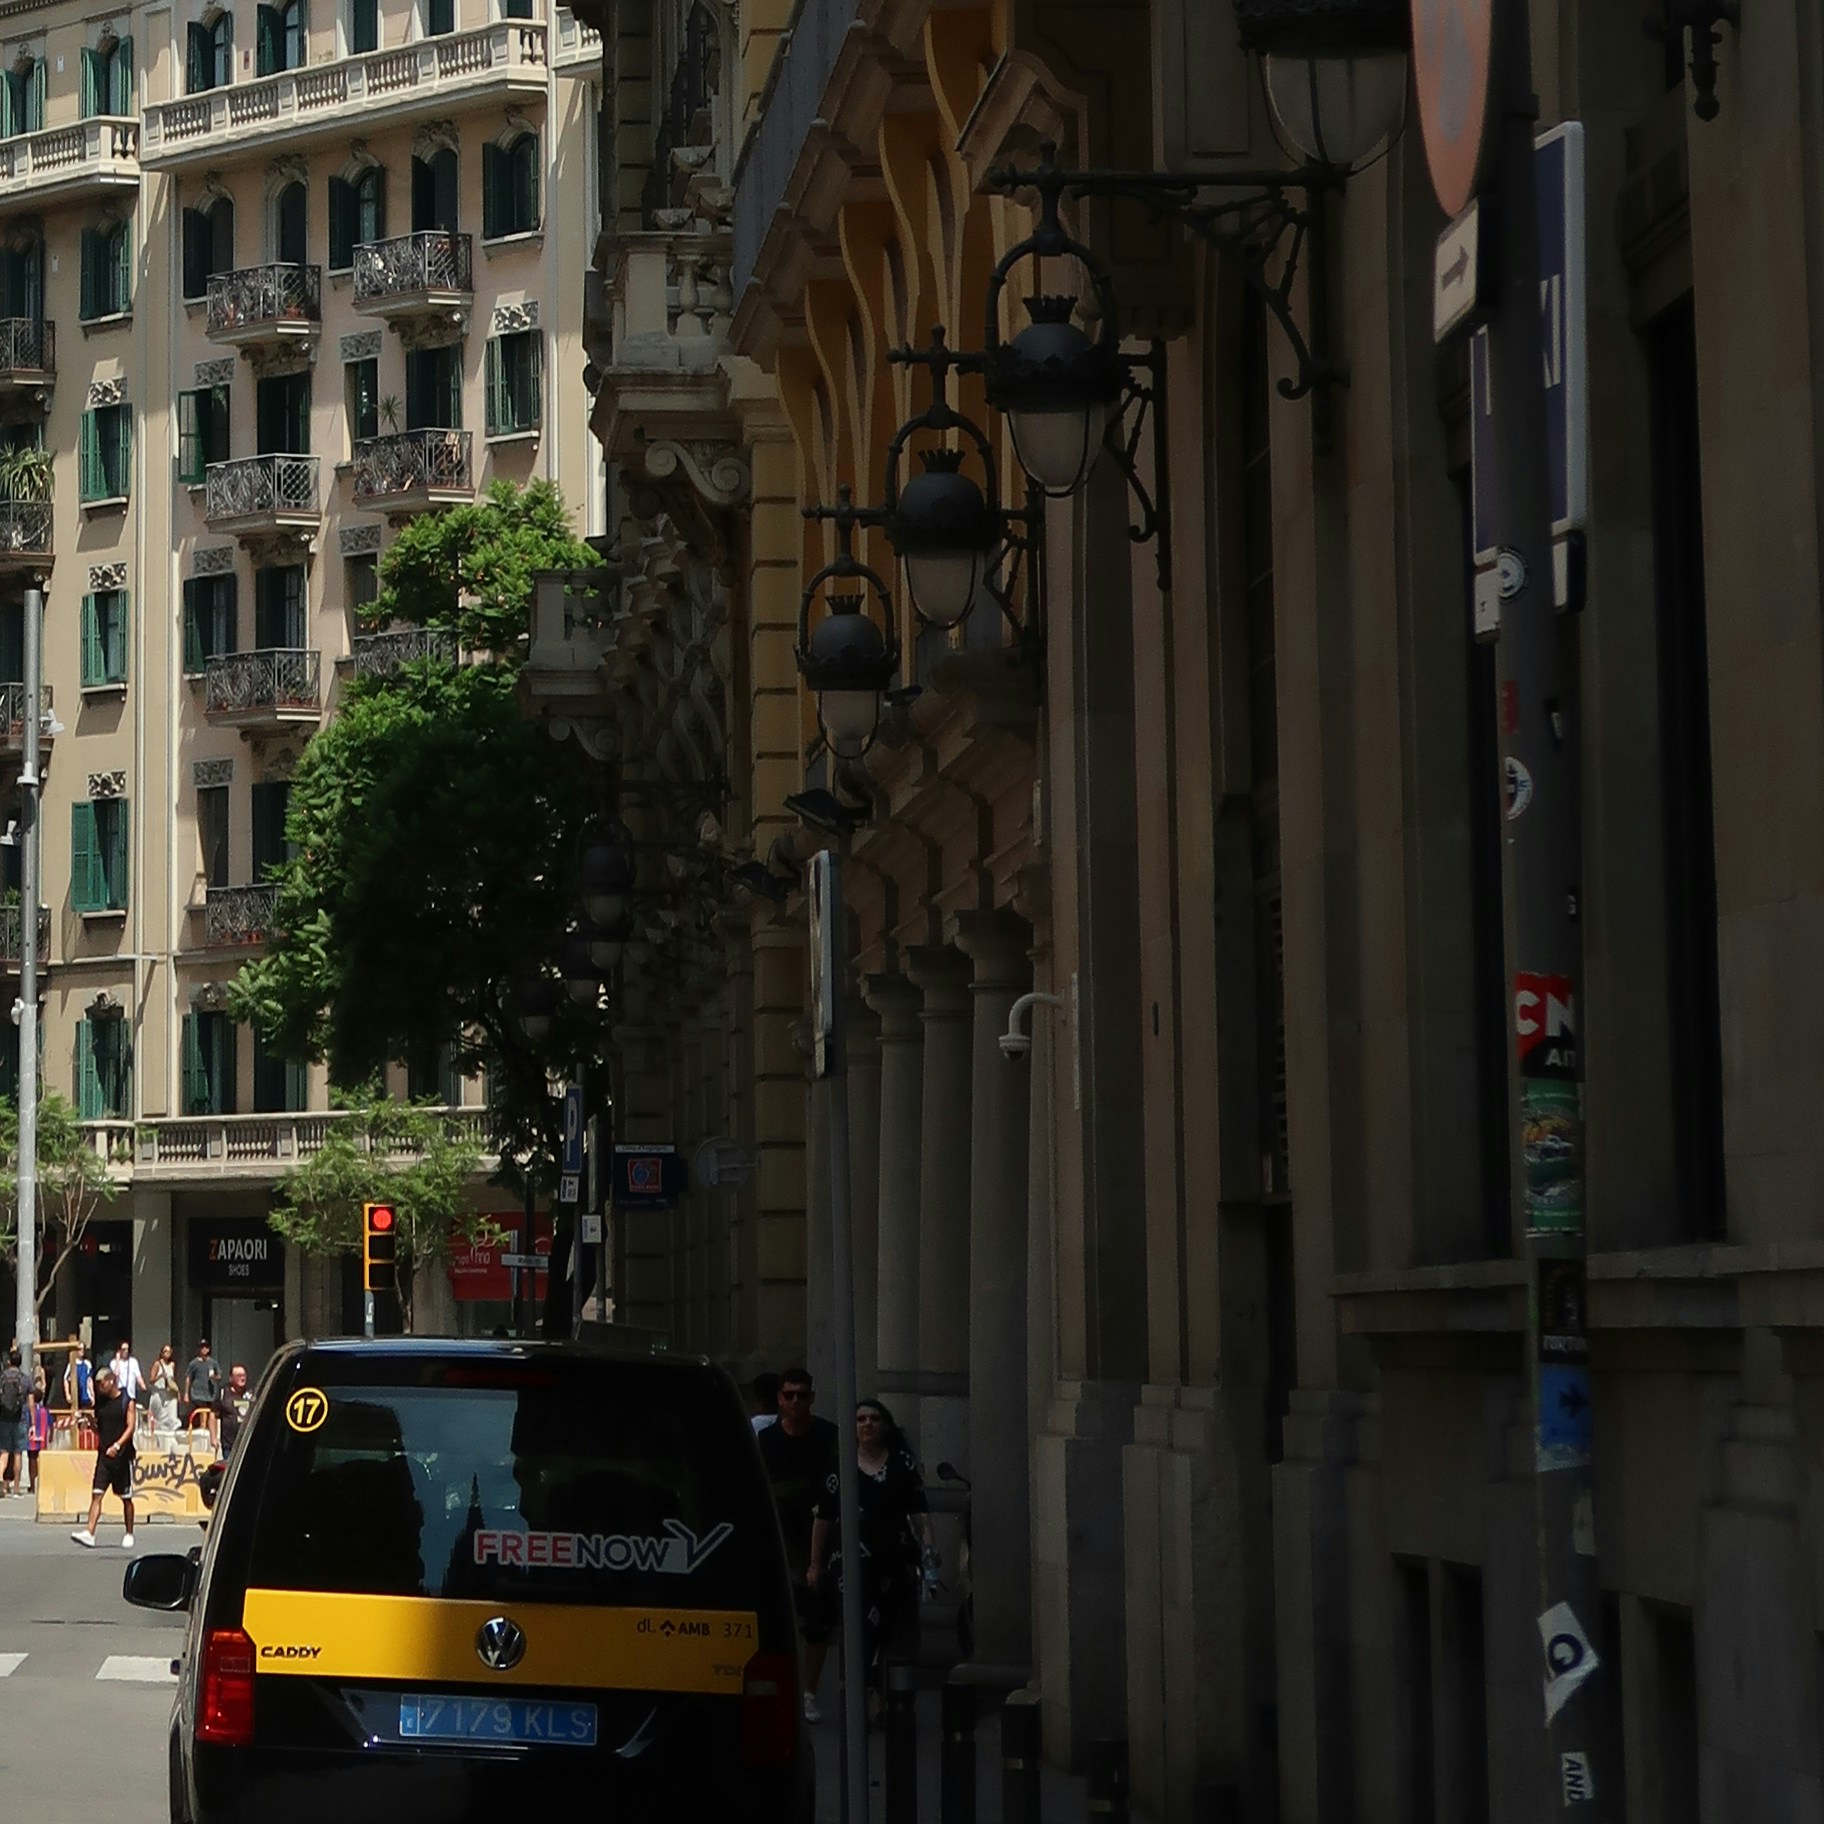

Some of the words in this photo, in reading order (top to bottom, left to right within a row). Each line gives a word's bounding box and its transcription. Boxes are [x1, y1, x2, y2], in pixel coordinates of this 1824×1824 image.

[209, 1238, 267, 1261] ZAPAORI
[228, 1264, 250, 1277] SHOES
[293, 1398, 321, 1424] 17
[475, 1530, 671, 1572] FREENOW
[678, 1622, 710, 1637] AMB
[723, 1622, 753, 1640] 371
[260, 1646, 322, 1659] CADDY
[426, 1701, 513, 1734] 7179
[526, 1706, 589, 1740] KLS
